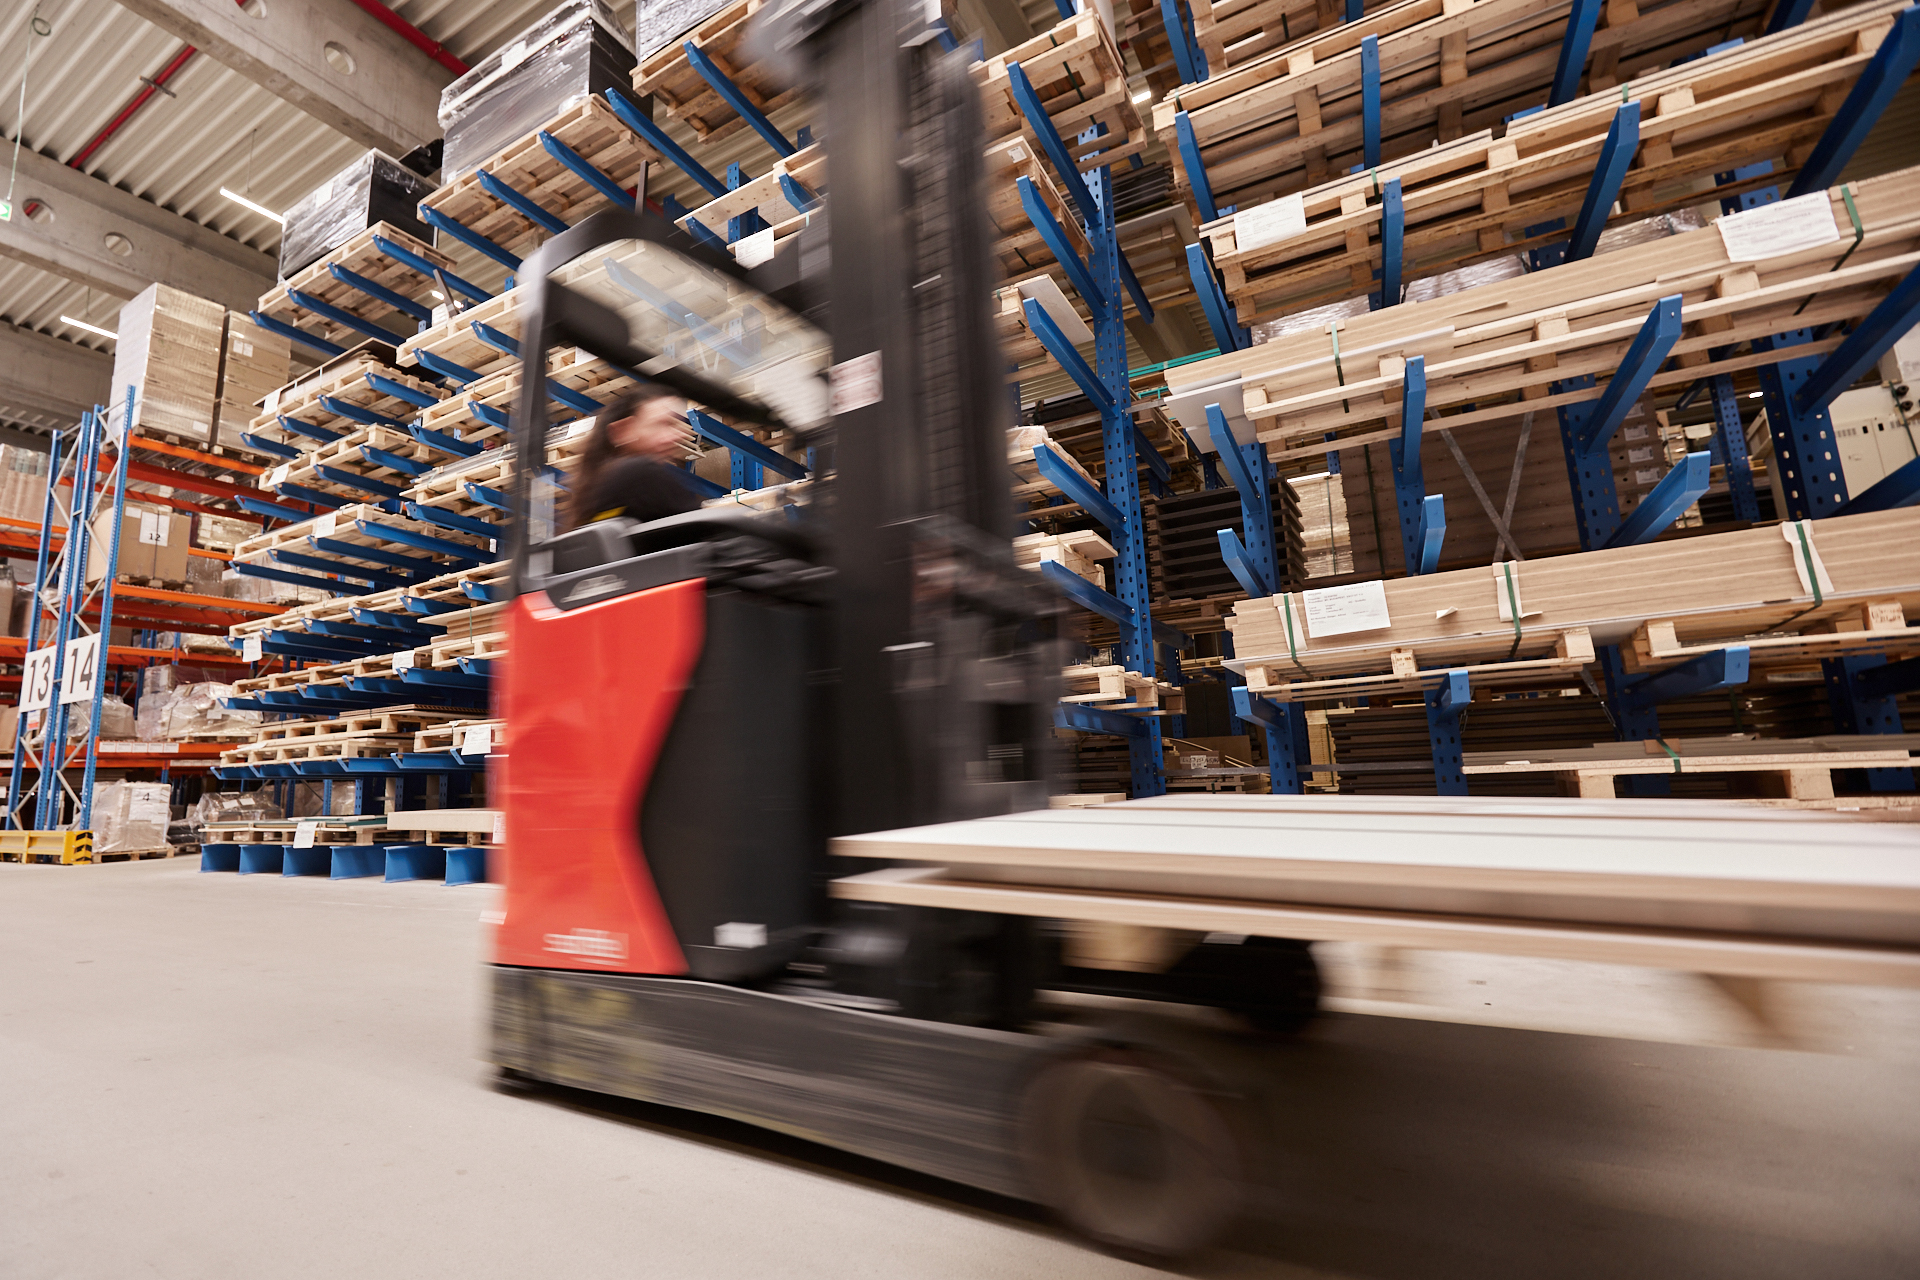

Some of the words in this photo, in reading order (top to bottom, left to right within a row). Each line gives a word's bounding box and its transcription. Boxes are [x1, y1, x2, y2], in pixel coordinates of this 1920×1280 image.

[149, 532, 160, 541] 12
[28, 655, 51, 703] 13
[69, 642, 96, 694] 14
